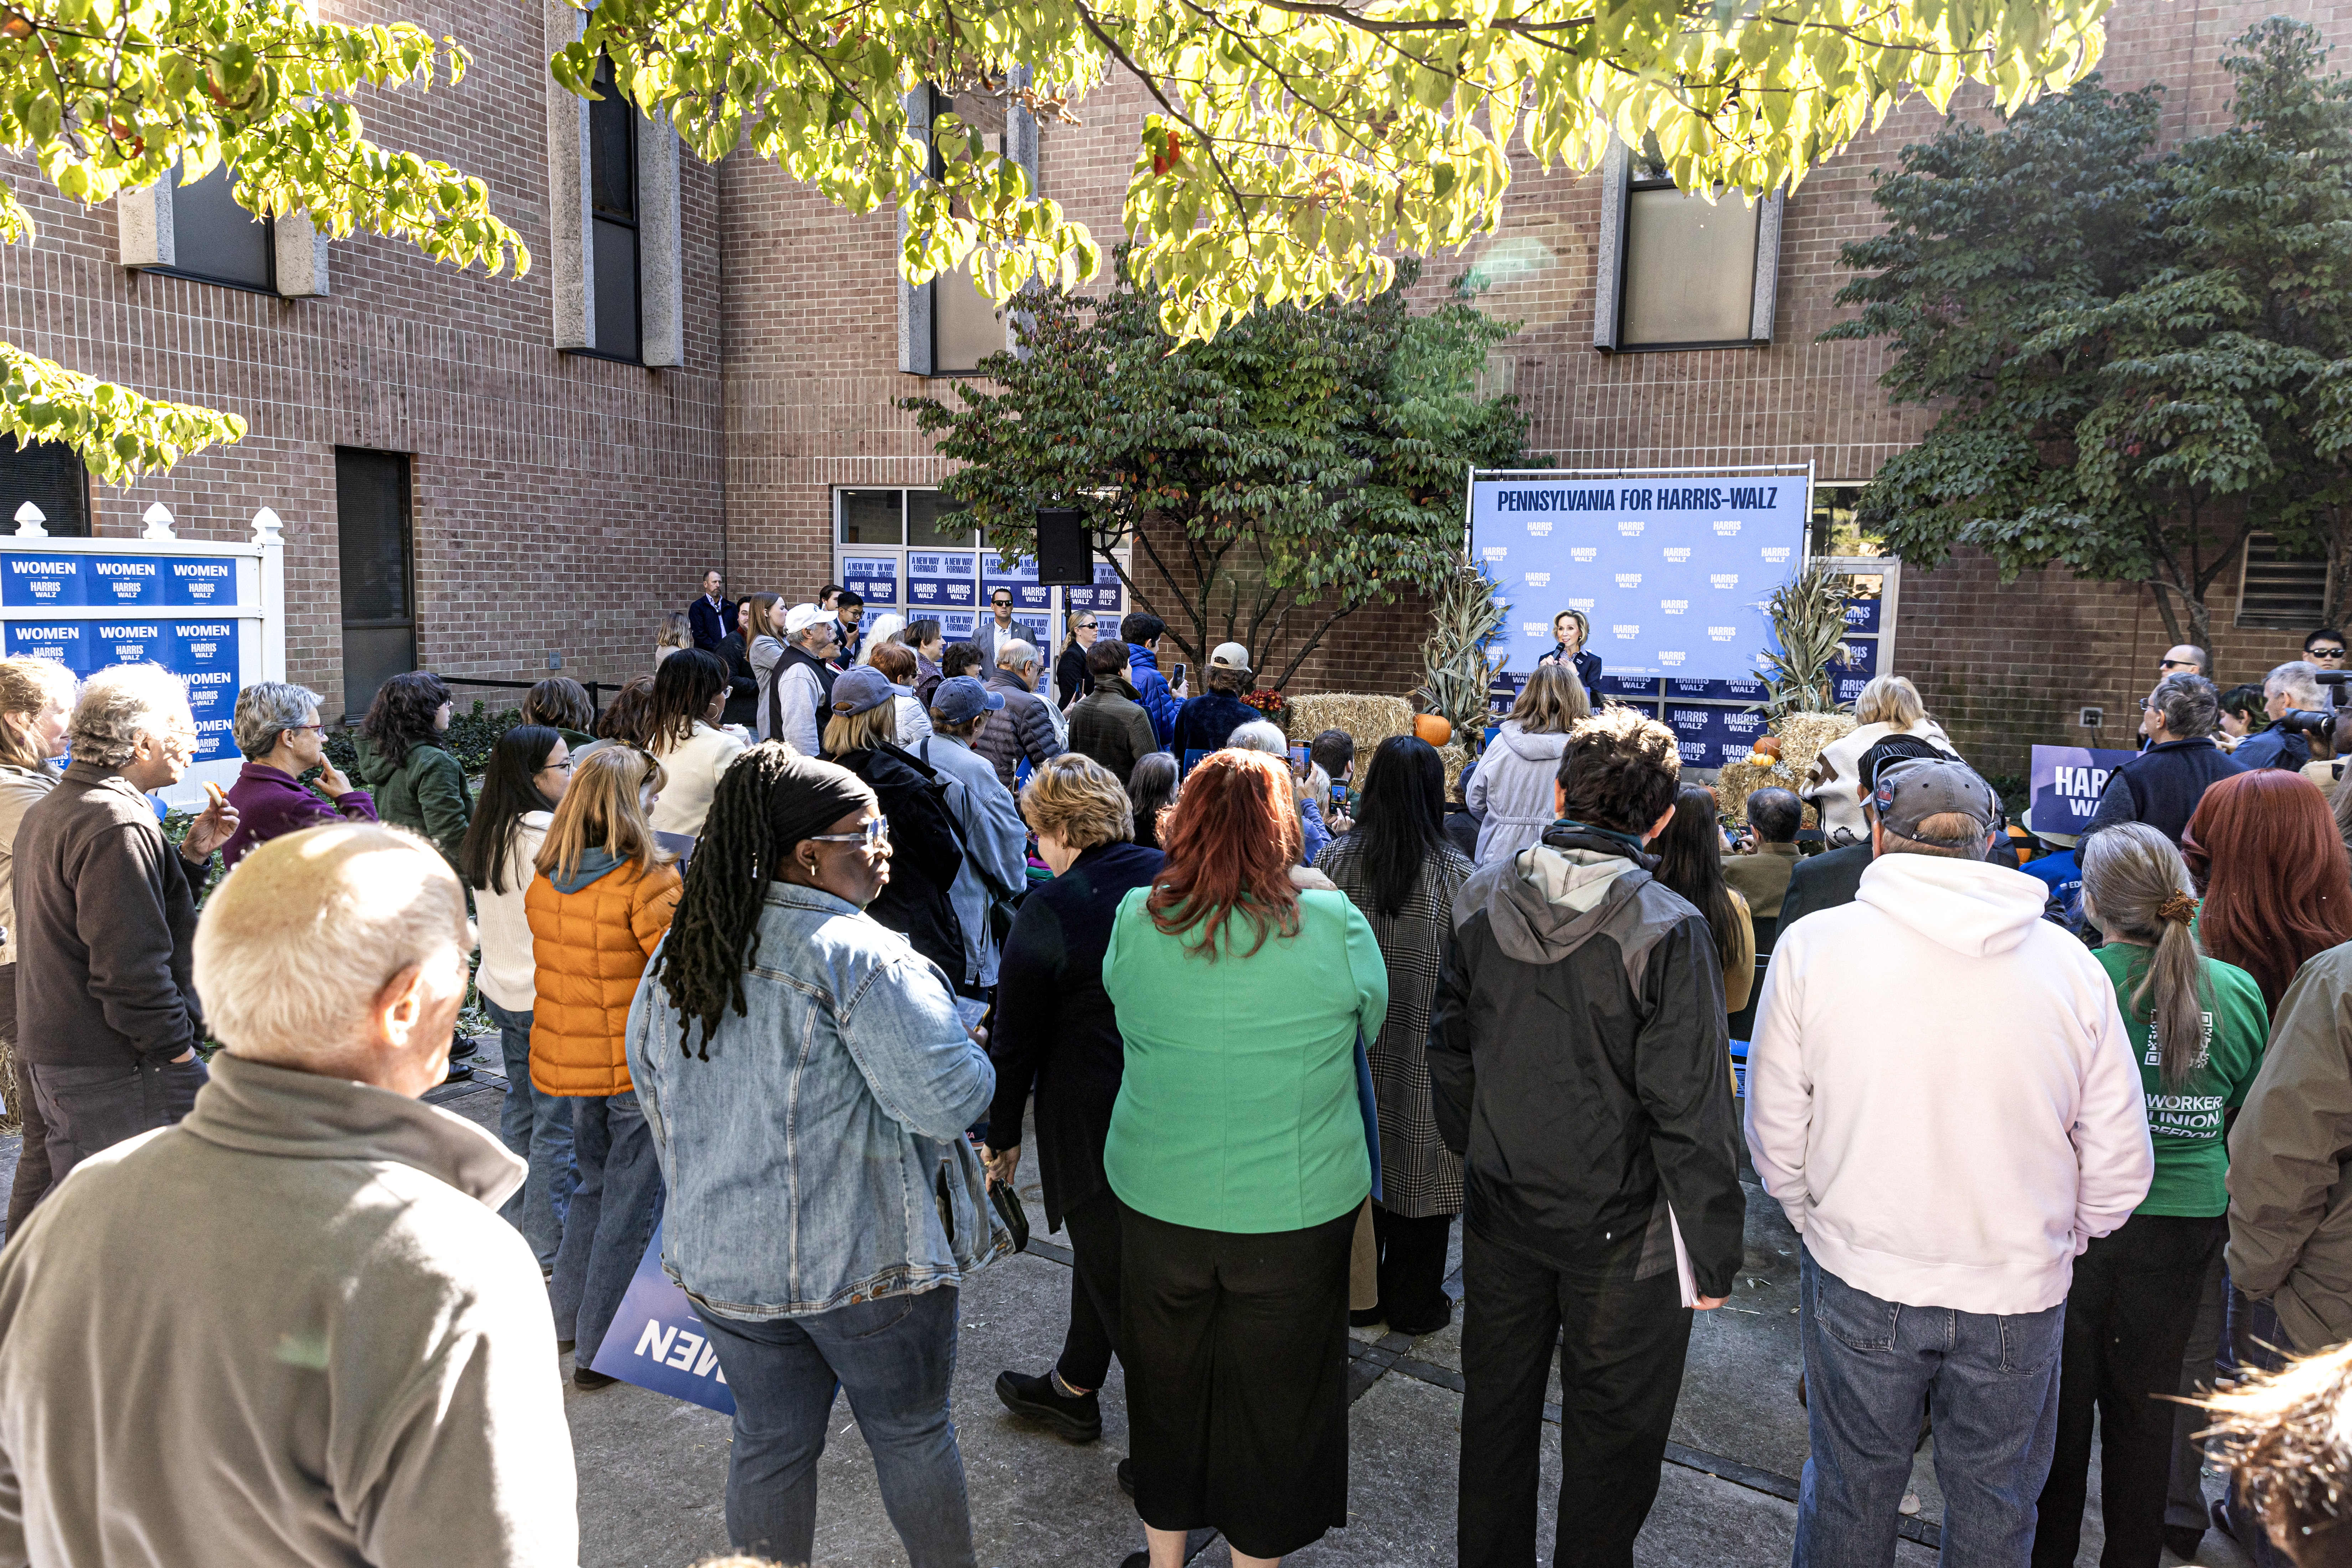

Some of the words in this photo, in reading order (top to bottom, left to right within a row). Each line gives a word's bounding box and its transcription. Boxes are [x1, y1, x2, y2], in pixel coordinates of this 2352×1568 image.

[1497, 489, 1615, 511] PENNSYLVANIA
[1620, 489, 1652, 511] FOR
[1657, 487, 1778, 510] HARRIS-WALZ
[1527, 522, 1552, 531] HARRIS
[1618, 521, 1645, 531] HARRIS
[1713, 521, 1741, 530] HARRIS
[1482, 547, 1507, 556] HARRIS
[1571, 547, 1597, 556] HARRIS
[1664, 547, 1691, 557] HARRIS
[1761, 547, 1790, 557] HARRIS
[950, 557, 961, 566] NEW
[962, 558, 973, 566] WAY
[12, 561, 76, 574] WOMEN
[96, 563, 155, 575] WOMEN
[173, 564, 228, 576] WOMEN
[947, 566, 971, 574] FORWARD
[1525, 572, 1550, 581] HARRIS
[1615, 573, 1642, 583] HARRIS
[1711, 574, 1738, 583] HARRIS
[30, 582, 61, 592] HARRIS
[113, 582, 141, 592] HARRIS
[189, 583, 215, 593] HARRIS
[870, 583, 892, 592] HARRIS
[914, 583, 937, 593] HARRIS
[947, 584, 970, 594] HARRIS
[1022, 586, 1046, 597] HARRIS
[1099, 589, 1116, 599] RRIS
[1569, 598, 1594, 607] HARRIS
[1661, 600, 1688, 609] HARRIS
[950, 615, 961, 624] NEW
[962, 616, 973, 624] WAY
[1037, 619, 1048, 627] WAY
[947, 624, 971, 632] FORWARD
[1107, 621, 1118, 629] WAY
[1523, 622, 1548, 631] HARRIS
[1613, 624, 1639, 634] HARRIS
[15, 627, 79, 640] WOMEN
[99, 626, 158, 638] WOMEN
[176, 625, 230, 637] WOMEN
[1708, 626, 1736, 636] HARRIS
[33, 647, 64, 657] HARRIS
[116, 645, 144, 655] HARRIS
[191, 643, 217, 653] HARRIS
[1659, 651, 1686, 660] HARRIS
[193, 690, 218, 700] HARRIS
[1674, 710, 1708, 723] HARRIS
[1724, 713, 1759, 726] HARRIS
[194, 719, 232, 732] OMEN
[1729, 724, 1753, 733] WALZ
[1678, 742, 1706, 754] ARRIS
[634, 1319, 727, 1384] MEN
